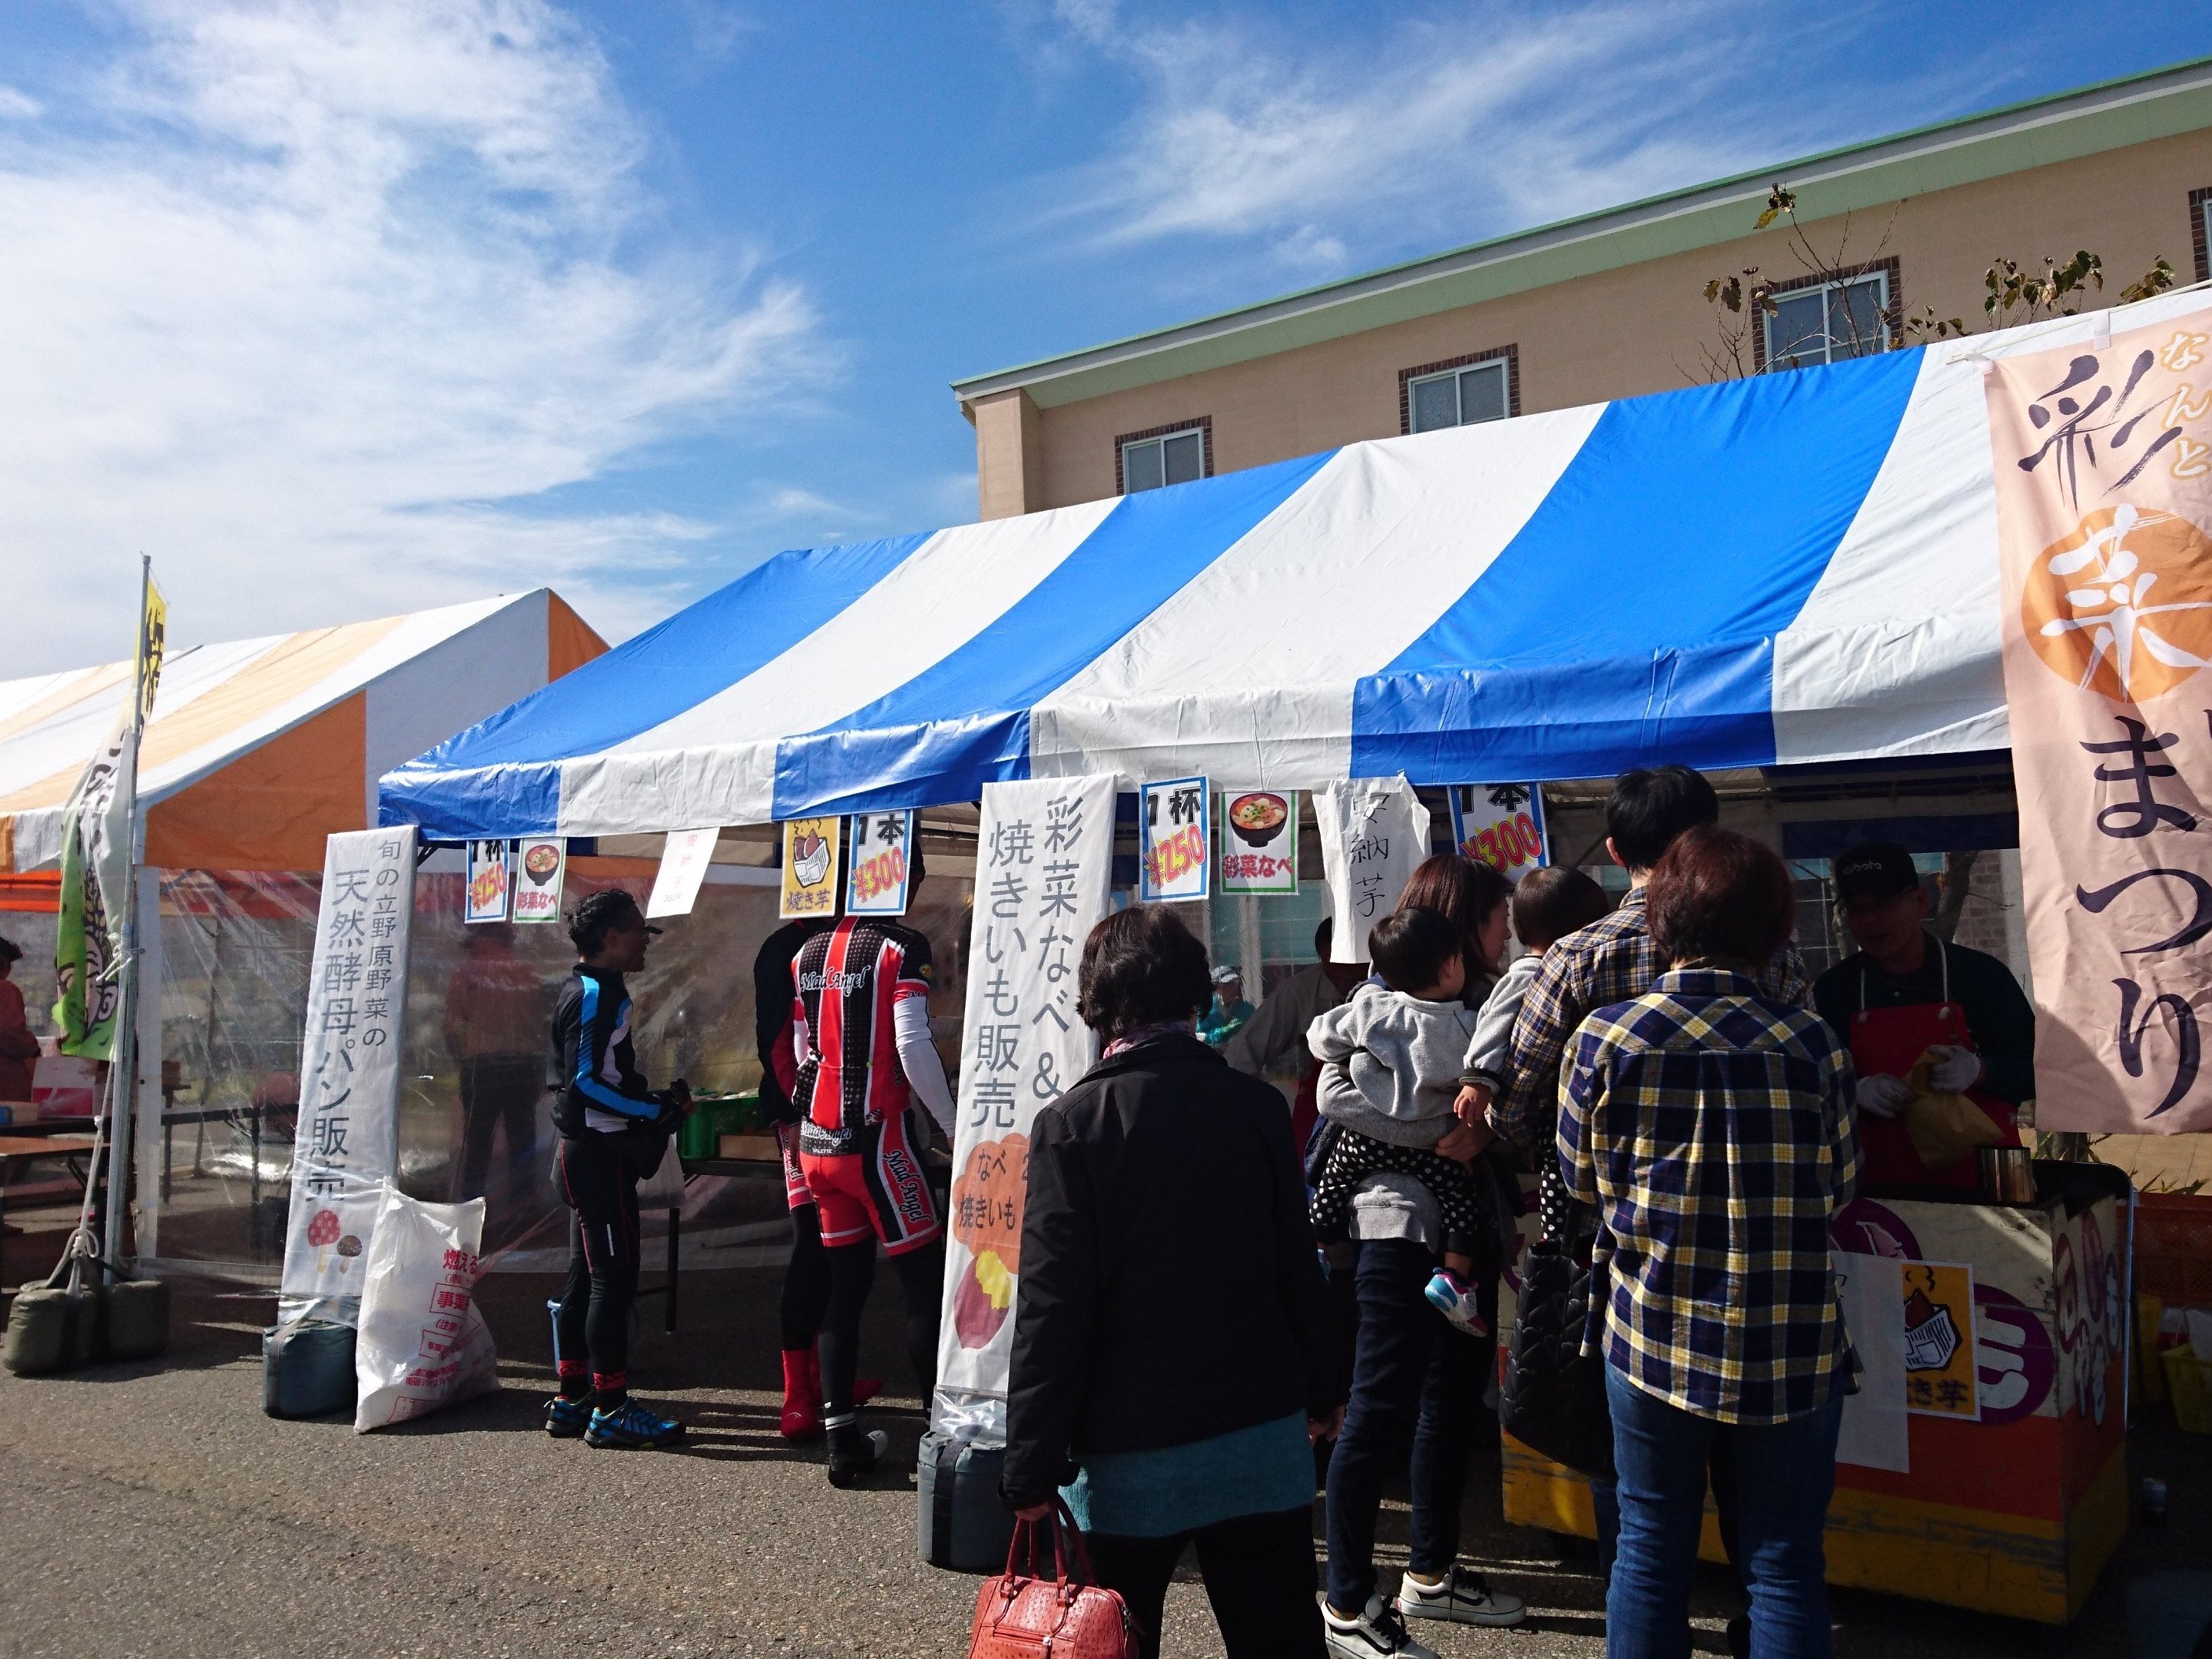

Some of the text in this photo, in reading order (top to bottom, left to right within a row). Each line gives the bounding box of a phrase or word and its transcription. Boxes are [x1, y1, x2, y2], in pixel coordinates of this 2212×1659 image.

[2161, 330, 2211, 479] なんと
[2018, 350, 2212, 1120] 彩菜まつり
[857, 813, 906, 846] 1本
[1147, 787, 1202, 828] 1杯
[851, 846, 907, 904] ¥300
[1143, 824, 1205, 889] ¥250
[1223, 854, 1294, 879] 彩菜なべ
[1350, 794, 1390, 917] 安納芋
[468, 861, 507, 912] ¥250
[516, 891, 559, 911] 彩菜なべ
[786, 889, 832, 912] 焼き芋
[363, 840, 402, 1047] 旬の立野原野菜の
[801, 964, 871, 997] Mad Angel
[970, 819, 1036, 1128] 焼きいも販売
[305, 870, 369, 1203] 天然酵母パン販売
[883, 1150, 931, 1223] Mad Angel
[977, 1148, 1007, 1182] なべ
[958, 1193, 1016, 1231] 焼きいも
[1907, 1377, 1969, 1409] き芋
